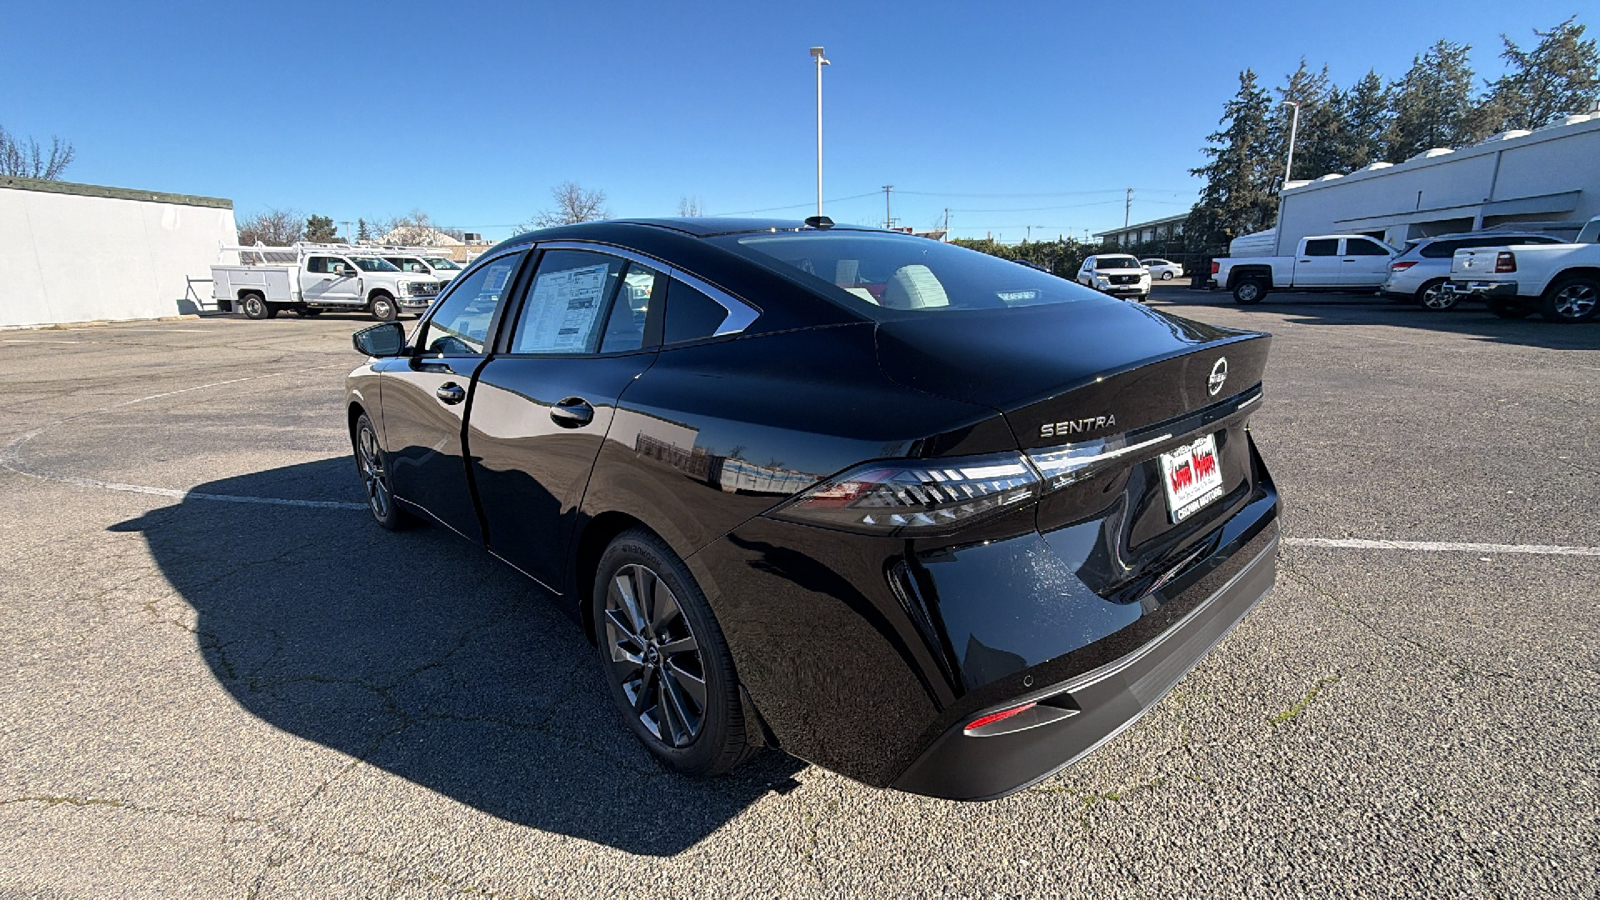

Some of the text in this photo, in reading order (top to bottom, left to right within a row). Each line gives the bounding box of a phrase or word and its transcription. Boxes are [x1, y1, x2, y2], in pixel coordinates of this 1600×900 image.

[1040, 414, 1116, 438] SENTRA
[1177, 499, 1200, 520] CROWN
[1199, 486, 1223, 509] MOTORS
